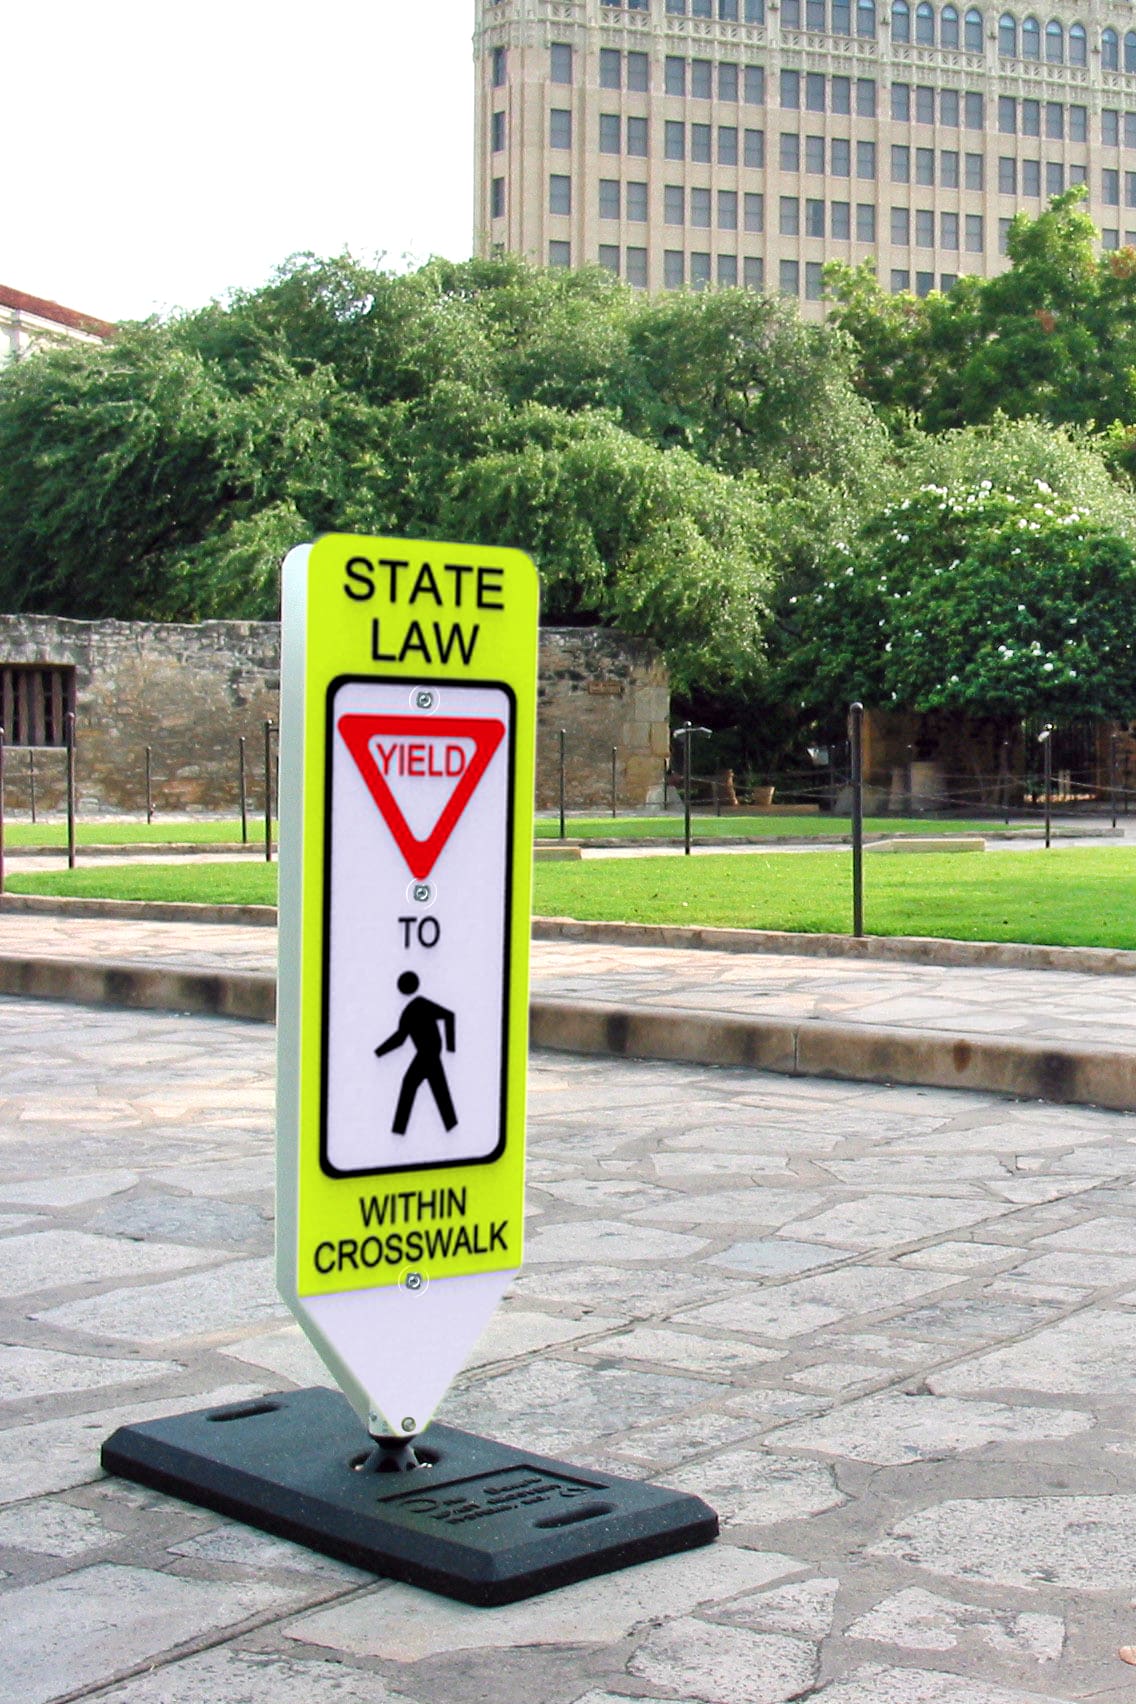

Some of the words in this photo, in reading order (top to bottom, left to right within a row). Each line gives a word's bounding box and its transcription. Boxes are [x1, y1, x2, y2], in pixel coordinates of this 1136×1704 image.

[343, 556, 505, 611] STATE
[371, 617, 480, 666] LAW
[376, 743, 466, 777] YIELD
[398, 915, 441, 949] TO
[359, 1186, 467, 1228] WITHIN
[314, 1220, 508, 1275] CROSSWALK
